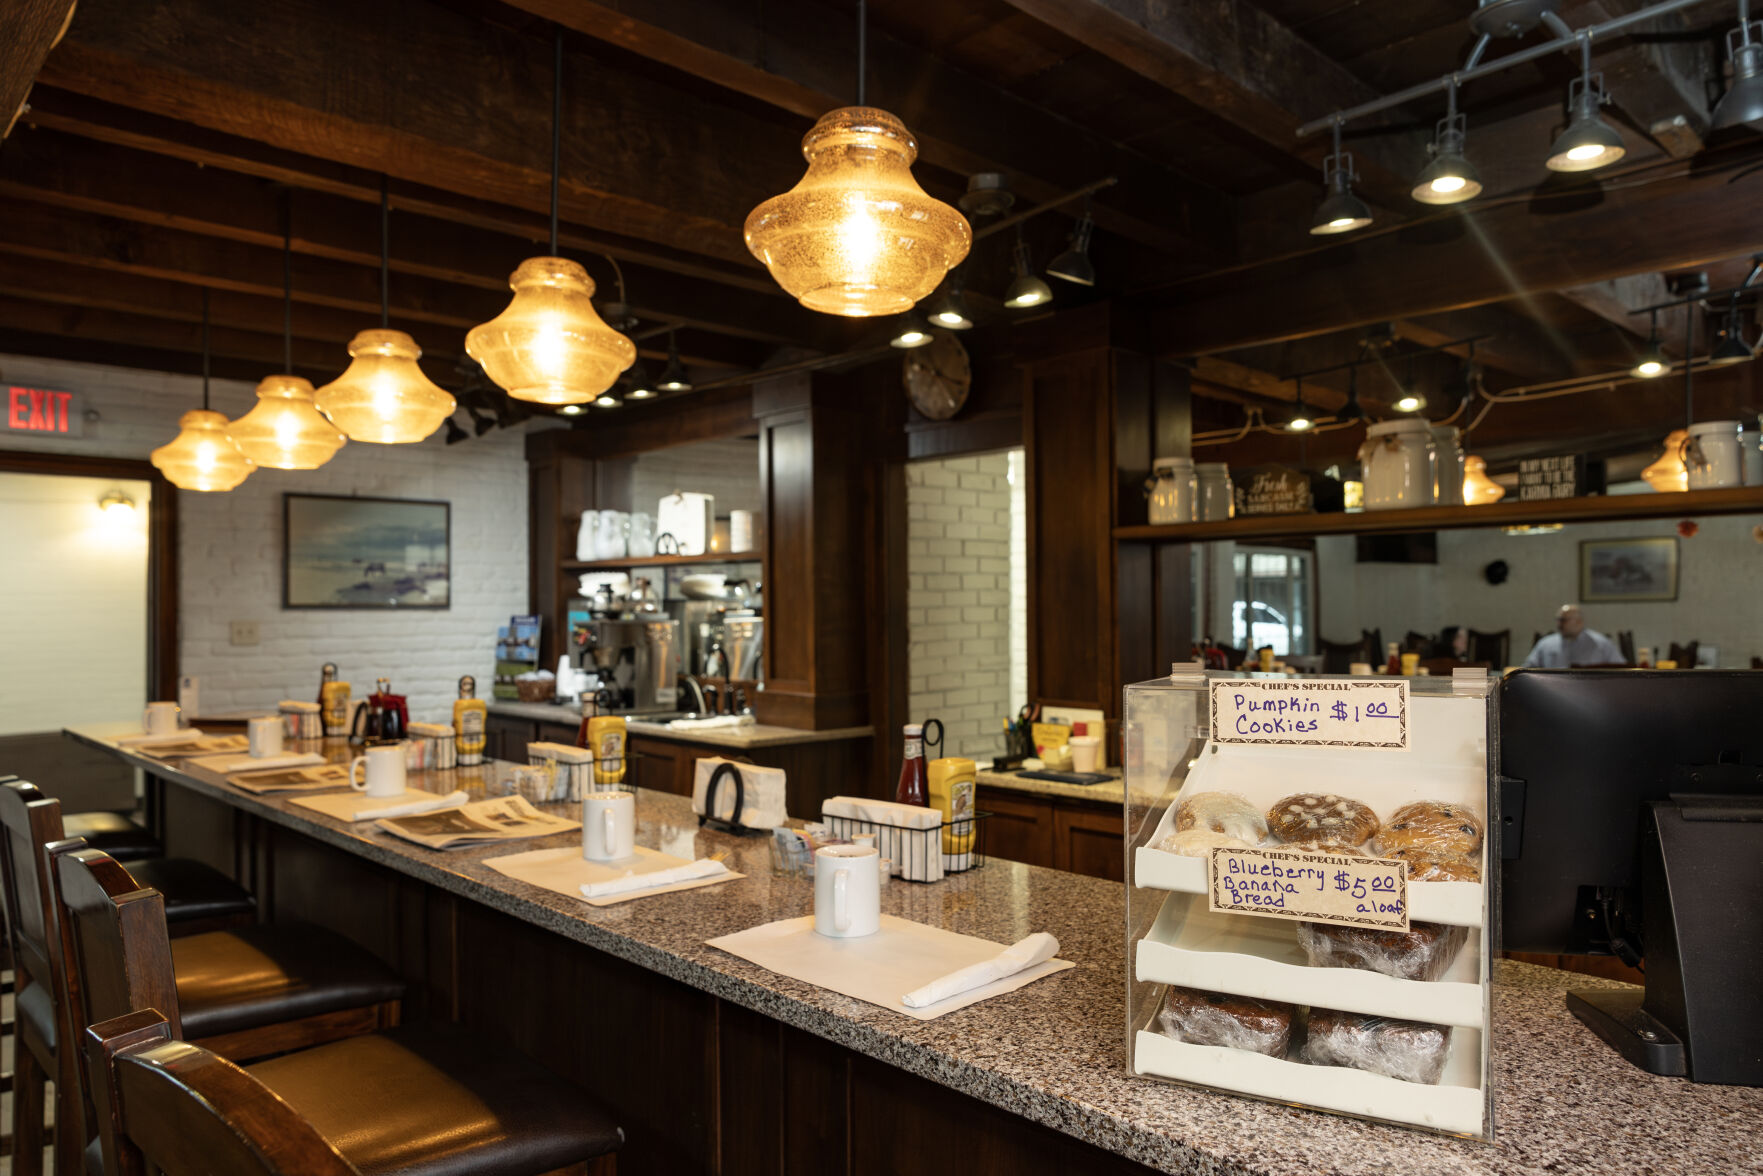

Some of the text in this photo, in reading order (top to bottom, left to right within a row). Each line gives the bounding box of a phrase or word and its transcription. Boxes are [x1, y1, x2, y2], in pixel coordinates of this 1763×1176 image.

[8, 386, 72, 433] EXIT
[1261, 683, 1351, 691] CHEF'S SPECIAL
[1234, 694, 1320, 715] Pumpkin
[1235, 714, 1318, 734] Cookies
[1262, 851, 1352, 866] CHEF'S SPECIAL
[1228, 858, 1325, 891] Blueberry
[1223, 875, 1300, 894] Banana
[1231, 889, 1285, 908] Bread
